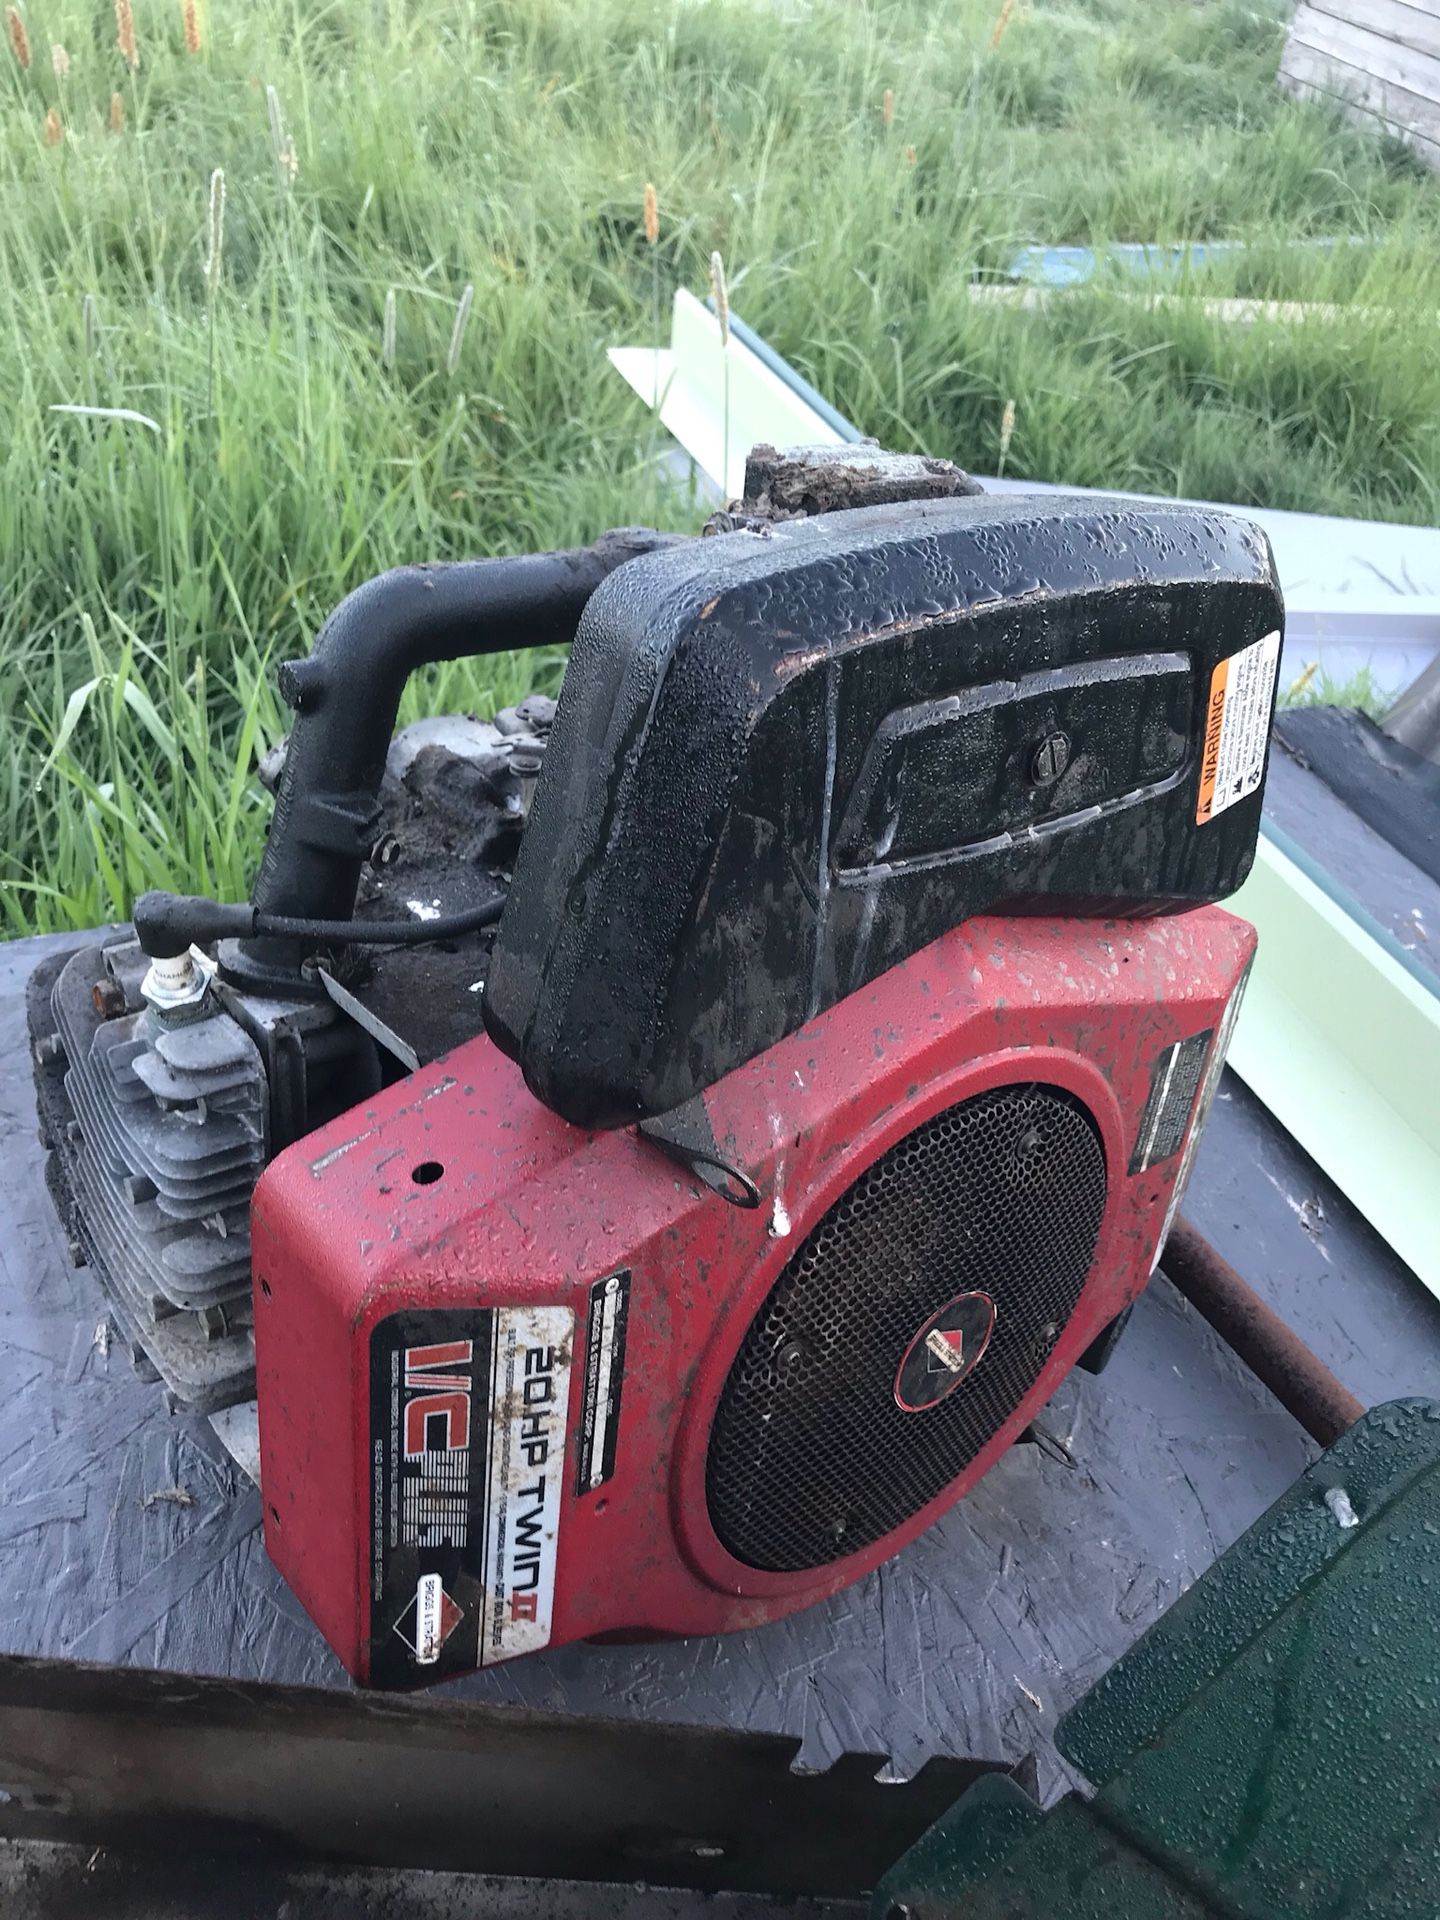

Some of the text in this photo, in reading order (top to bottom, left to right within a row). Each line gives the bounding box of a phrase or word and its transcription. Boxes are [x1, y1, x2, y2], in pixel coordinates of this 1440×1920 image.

[1204, 689, 1225, 786] WARNING
[590, 1296, 603, 1344] BRIGGS
[590, 1342, 599, 1353] &
[522, 1345, 555, 1405] 20
[584, 1350, 599, 1409] STRATTON
[402, 1339, 473, 1547] I/C PLUS
[518, 1409, 550, 1468] HP
[373, 1438, 384, 1601] READ INSTRUCTIONS BEFORE STARTING
[512, 1476, 546, 1591] TWIN
[424, 1579, 434, 1610] BRIGGS
